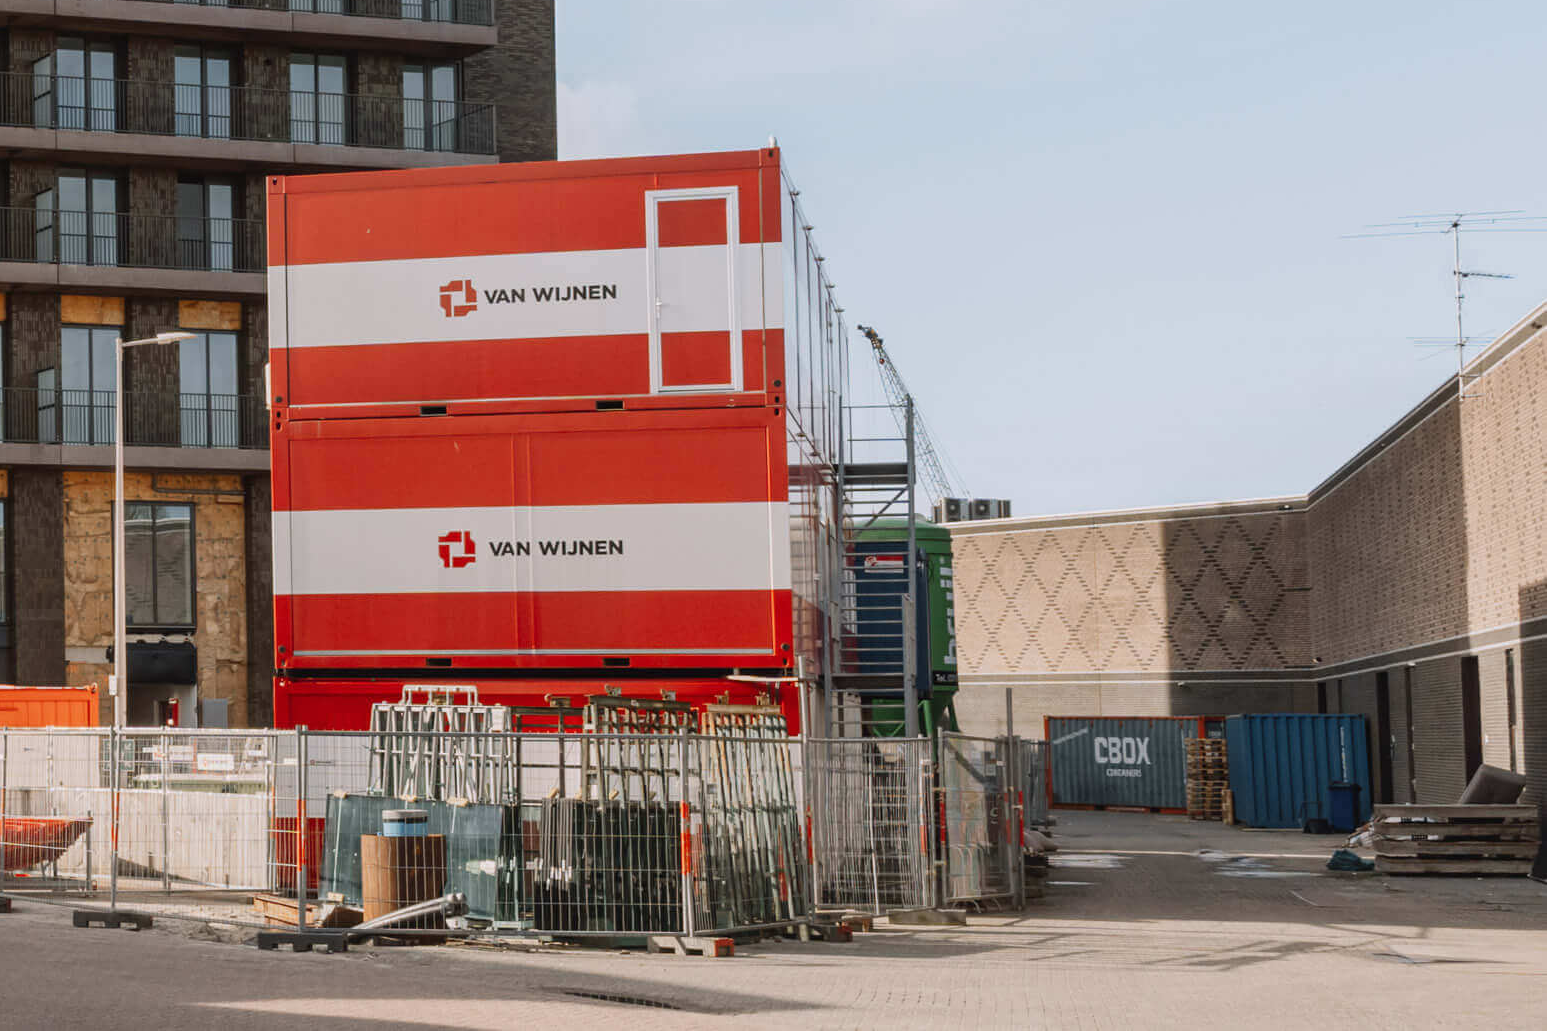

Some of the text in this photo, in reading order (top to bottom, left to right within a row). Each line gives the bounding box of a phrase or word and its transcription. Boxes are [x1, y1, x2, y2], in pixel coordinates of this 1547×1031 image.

[484, 284, 617, 304] VAN WIJNEN
[489, 540, 624, 556] VAN WIJNEN
[1094, 736, 1152, 765] CBOX
